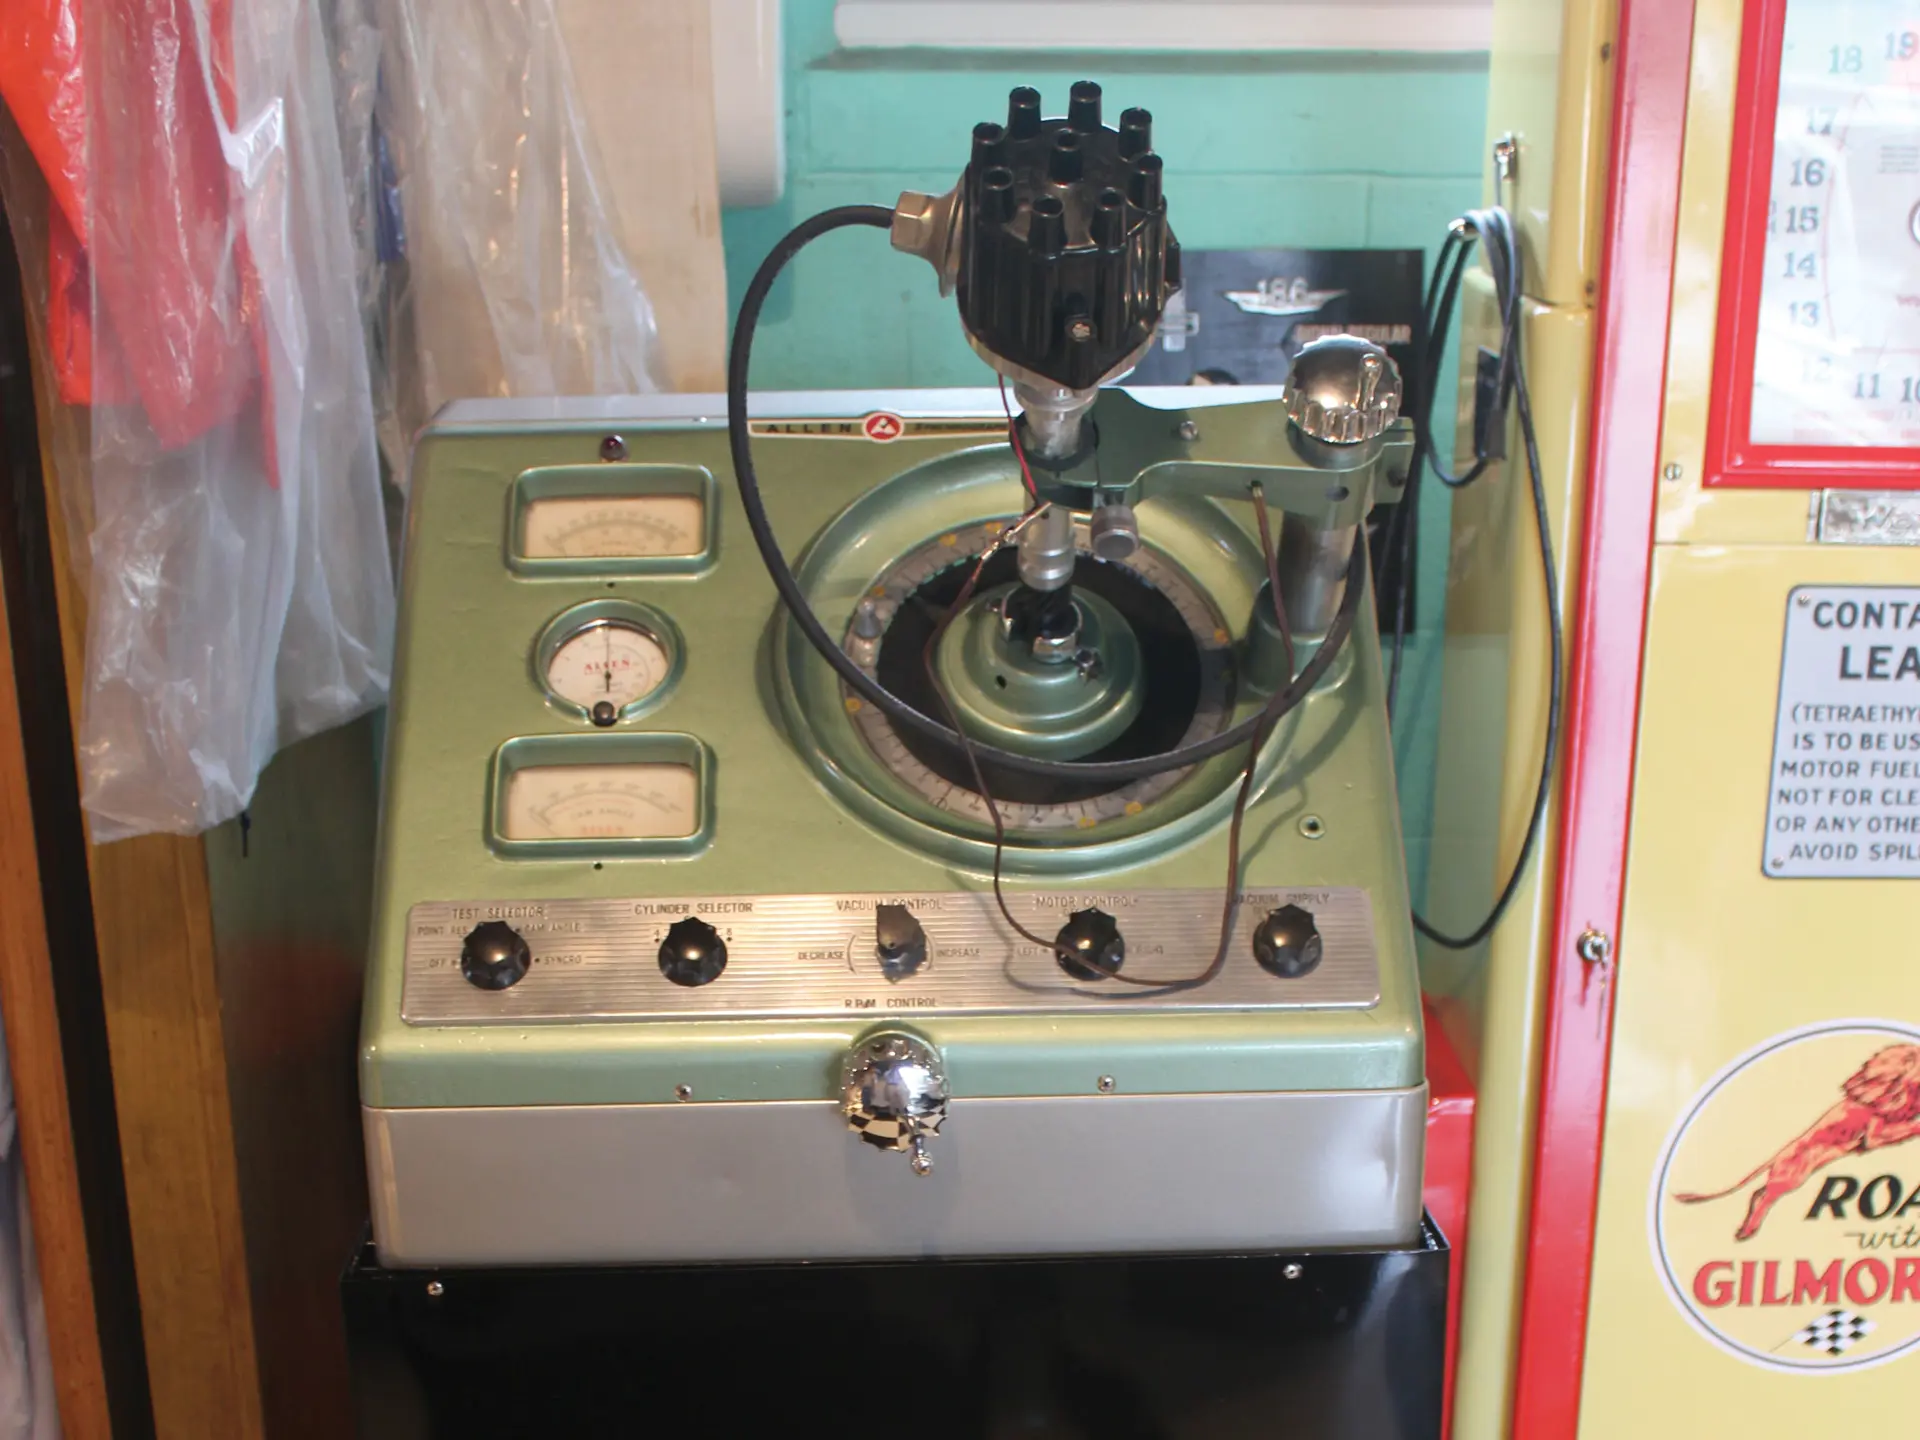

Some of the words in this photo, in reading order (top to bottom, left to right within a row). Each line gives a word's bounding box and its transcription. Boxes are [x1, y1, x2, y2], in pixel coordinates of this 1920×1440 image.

[1885, 31, 1920, 61] 19
[1828, 44, 1863, 74] 18
[1806, 107, 1838, 136] 17
[1790, 158, 1826, 187] 16
[1786, 206, 1819, 234] 15
[1783, 252, 1816, 279] 14
[1789, 301, 1820, 327] 13
[1854, 373, 1880, 398] 11
[766, 423, 852, 434] ALLEN
[1839, 646, 1920, 681] LEA
[1793, 732, 1815, 751] IS
[1825, 732, 1853, 751] TO
[1860, 732, 1888, 751] BE
[1894, 732, 1920, 751] US
[1780, 760, 1860, 779] MOTOR
[1777, 789, 1823, 807] NOT
[1828, 788, 1873, 807] FOR
[1881, 788, 1920, 806] CLE
[1775, 816, 1807, 833] OR
[1815, 816, 1862, 833] ANY
[1867, 815, 1920, 833] OTHE
[1789, 844, 1858, 861] AVOID
[452, 908, 480, 920] TEST
[487, 906, 544, 919] SELECTOR
[635, 903, 690, 915] CYLINDER
[696, 902, 753, 914] SELECTOR
[1036, 896, 1077, 908] MOTOR
[886, 997, 938, 1008] CONTROL
[1692, 1256, 1920, 1308] GILMOR
